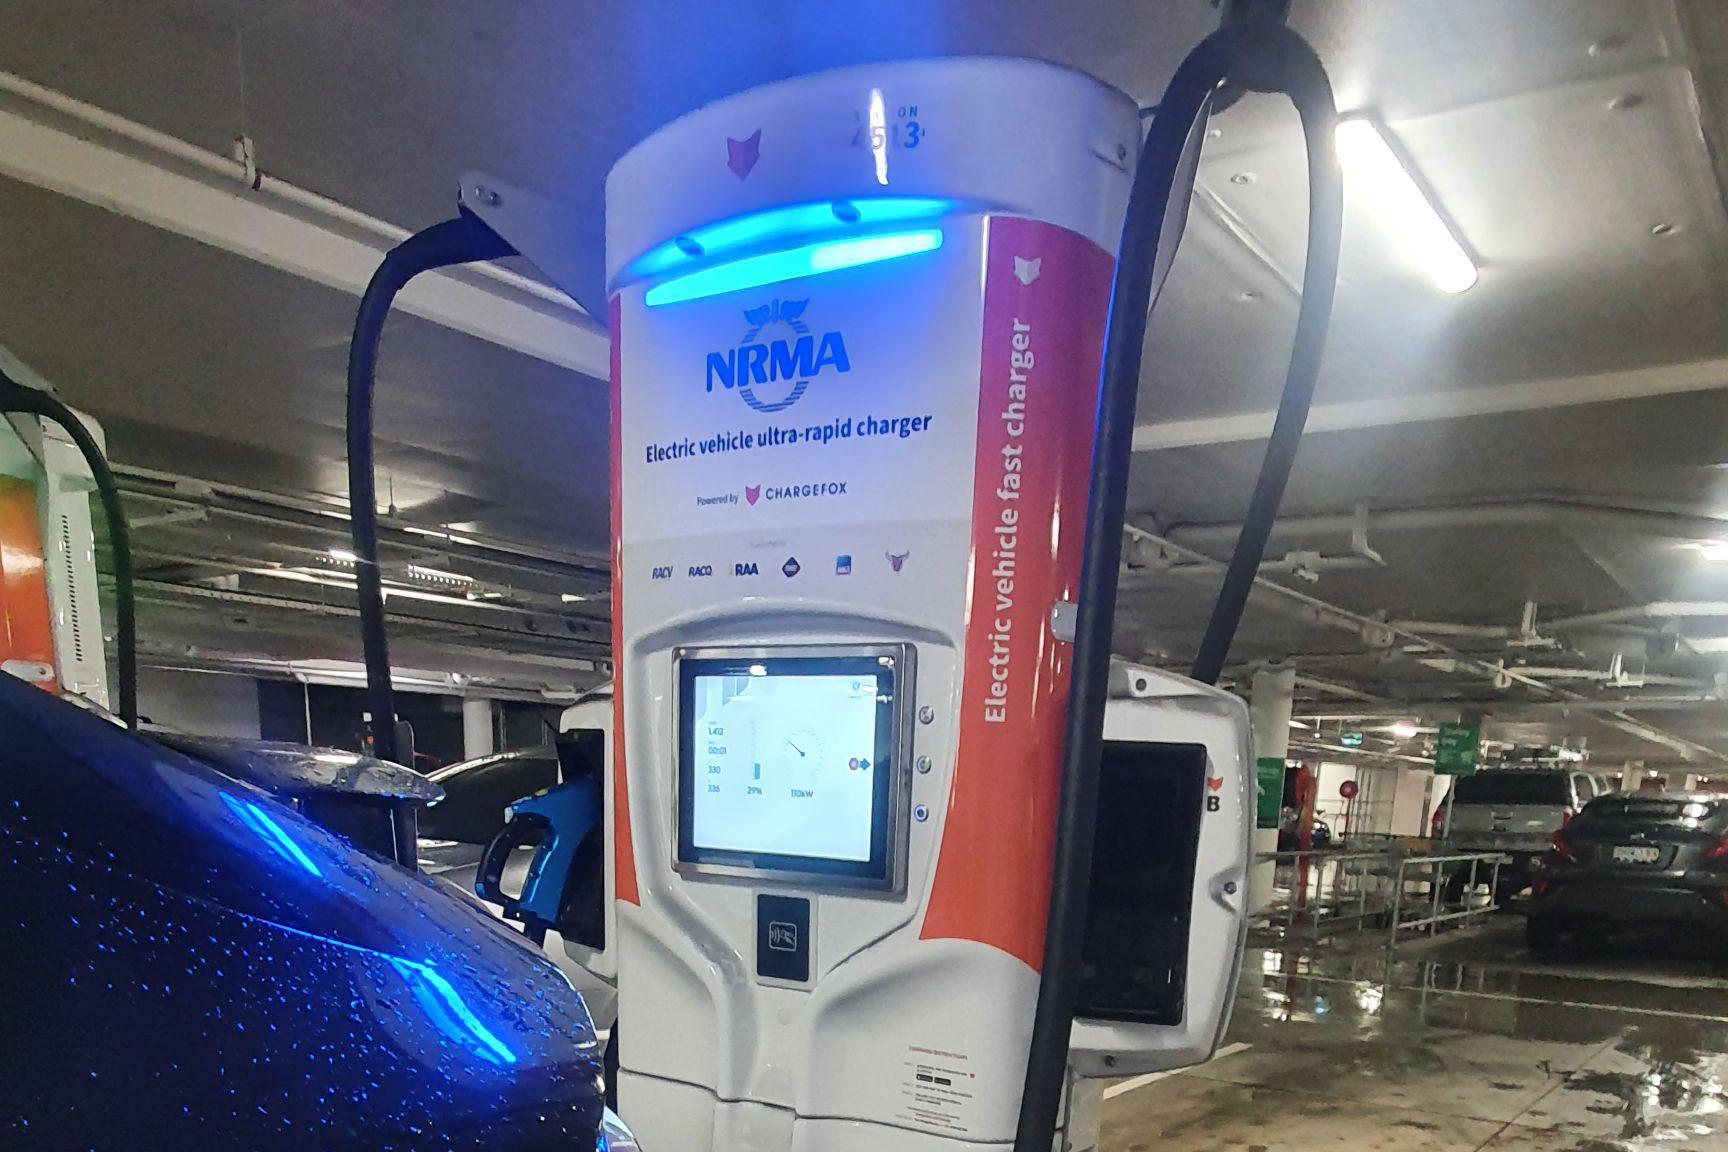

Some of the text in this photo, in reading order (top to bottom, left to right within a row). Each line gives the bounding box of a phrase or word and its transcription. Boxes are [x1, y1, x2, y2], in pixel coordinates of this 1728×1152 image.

[706, 331, 851, 393] NRMA
[645, 414, 933, 464] Electric vehicle ultra-rapid charger
[696, 493, 739, 506] Powered by
[765, 482, 848, 501] CHARGEFOX
[984, 317, 1035, 724] Electric vehicle fast charger
[652, 566, 674, 580] RACV
[688, 564, 713, 577] RACQ
[735, 562, 759, 577] RAA
[1206, 795, 1221, 812] B
